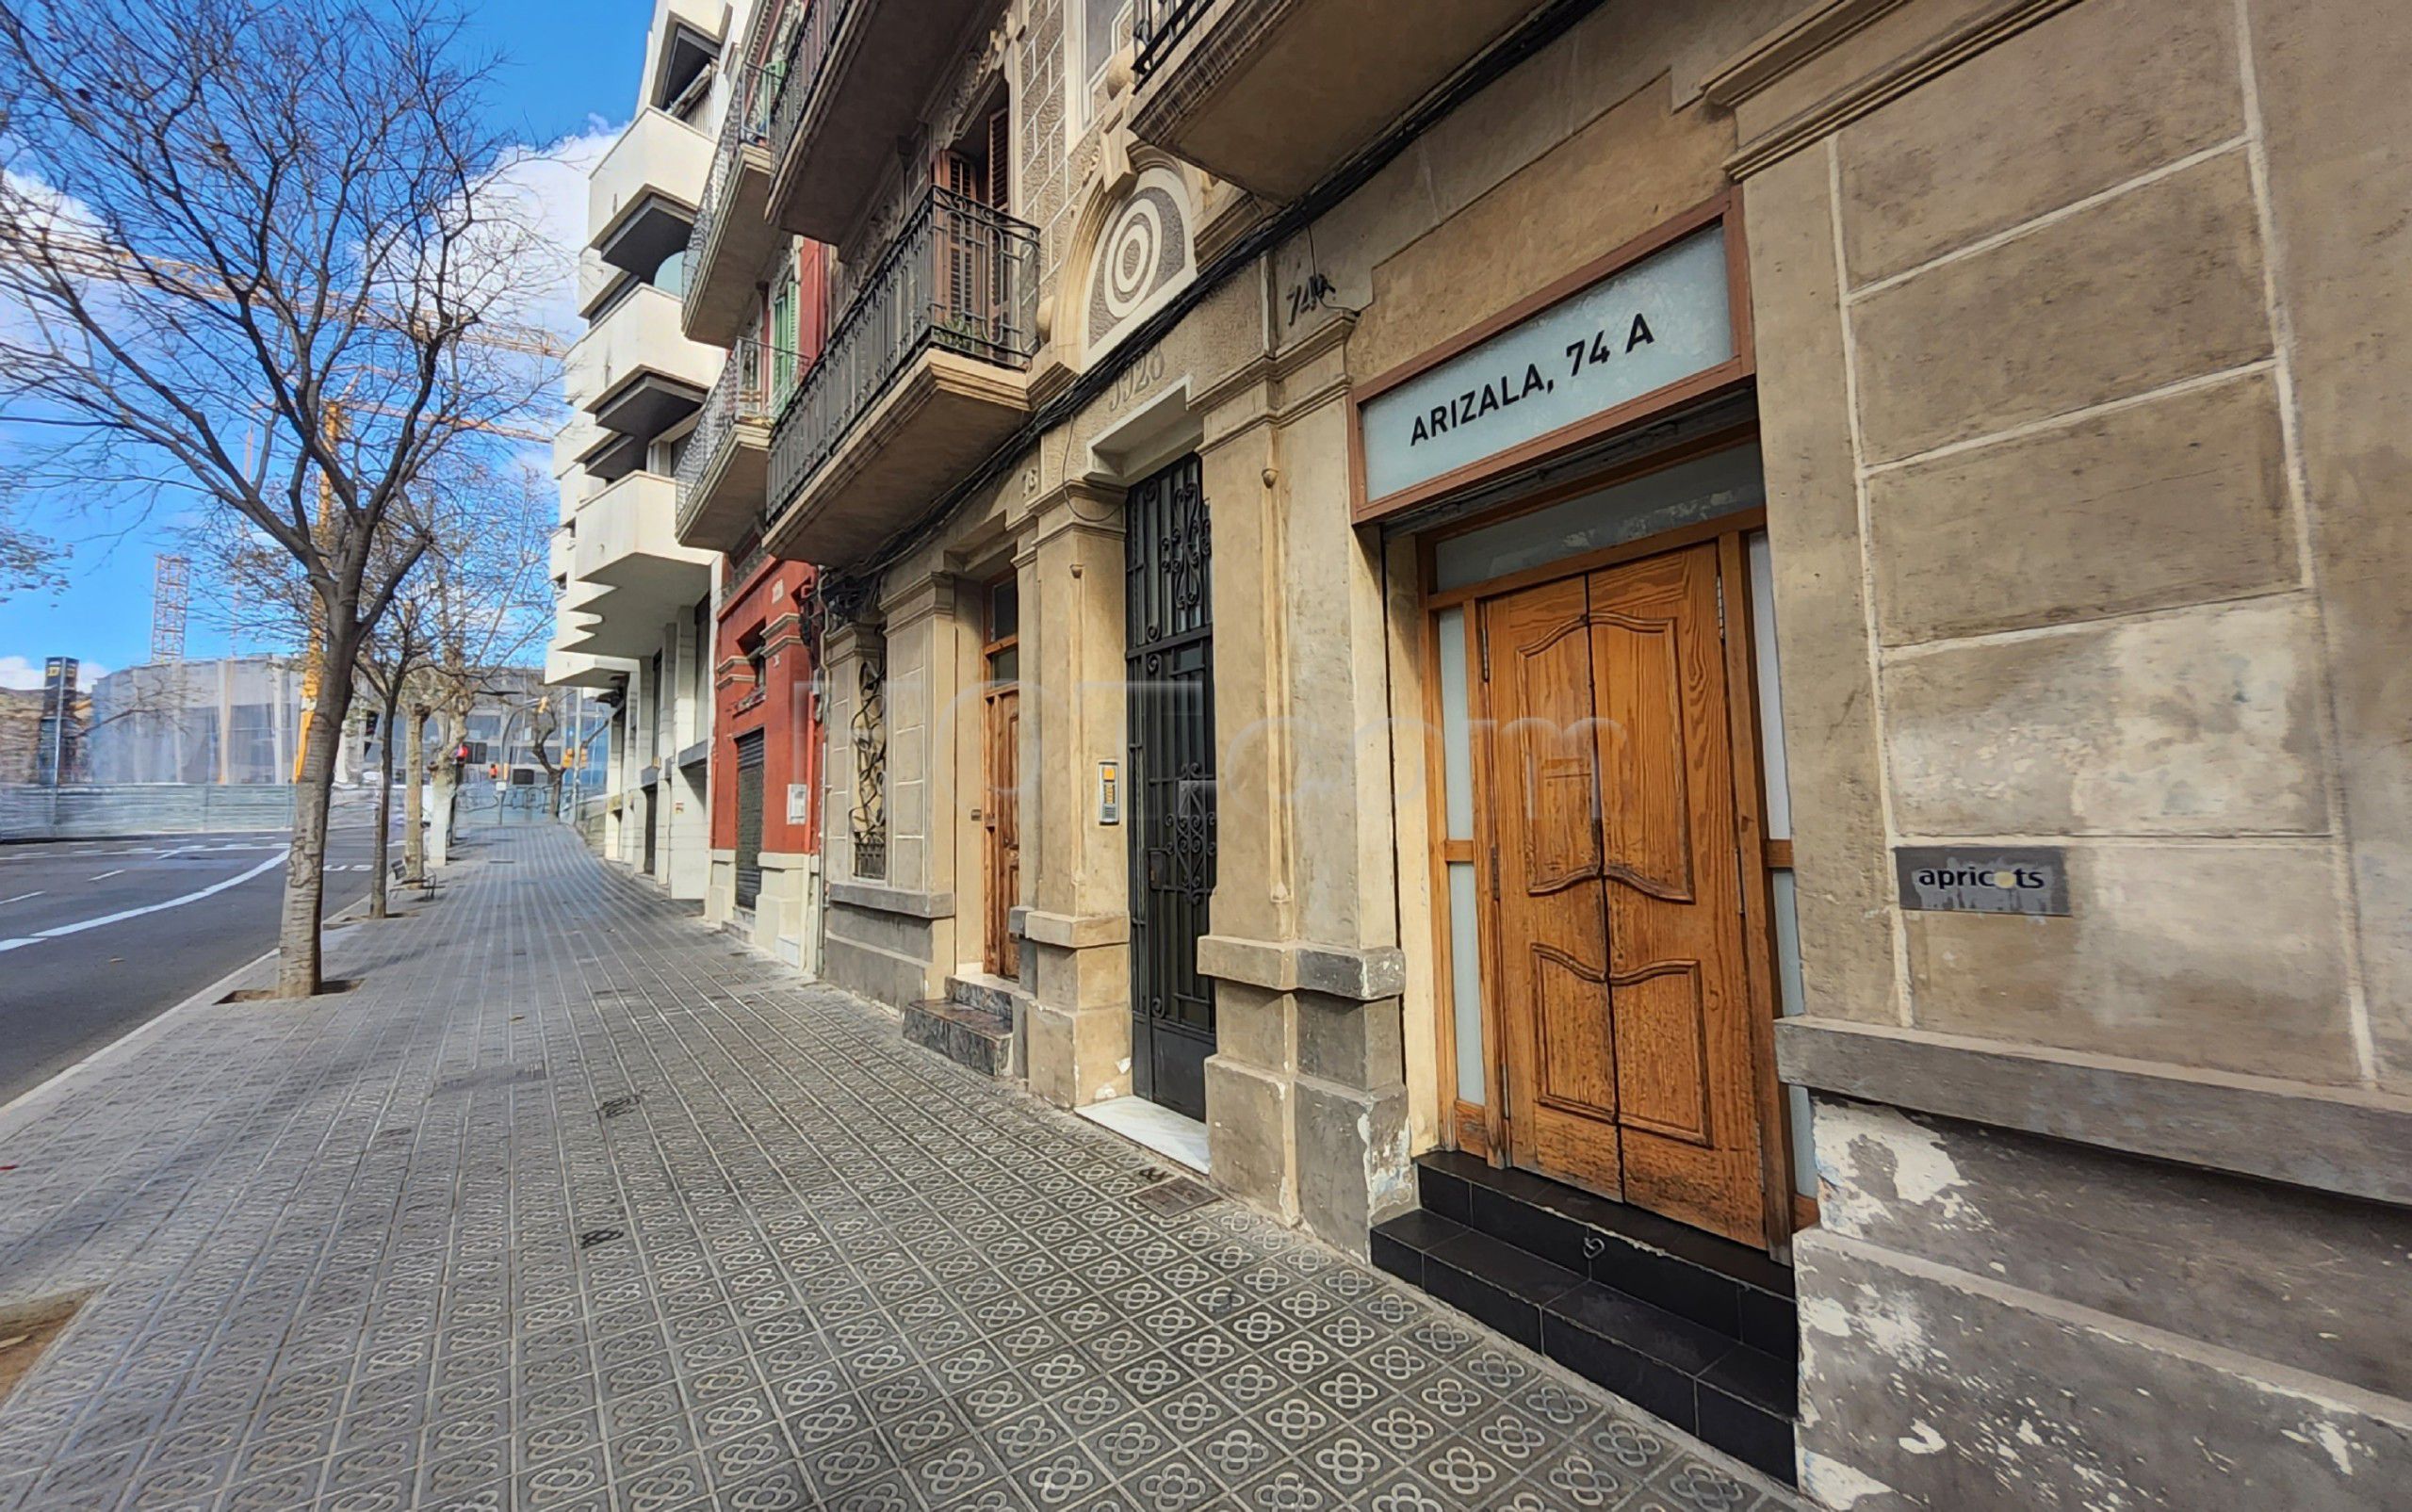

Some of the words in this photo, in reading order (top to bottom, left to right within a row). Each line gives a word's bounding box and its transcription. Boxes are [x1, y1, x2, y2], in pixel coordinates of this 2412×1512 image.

[1410, 363, 1554, 447] ARIZALA,
[1566, 330, 1610, 377] 74
[1625, 313, 1654, 354] A
[1918, 866, 2045, 890] apricots
